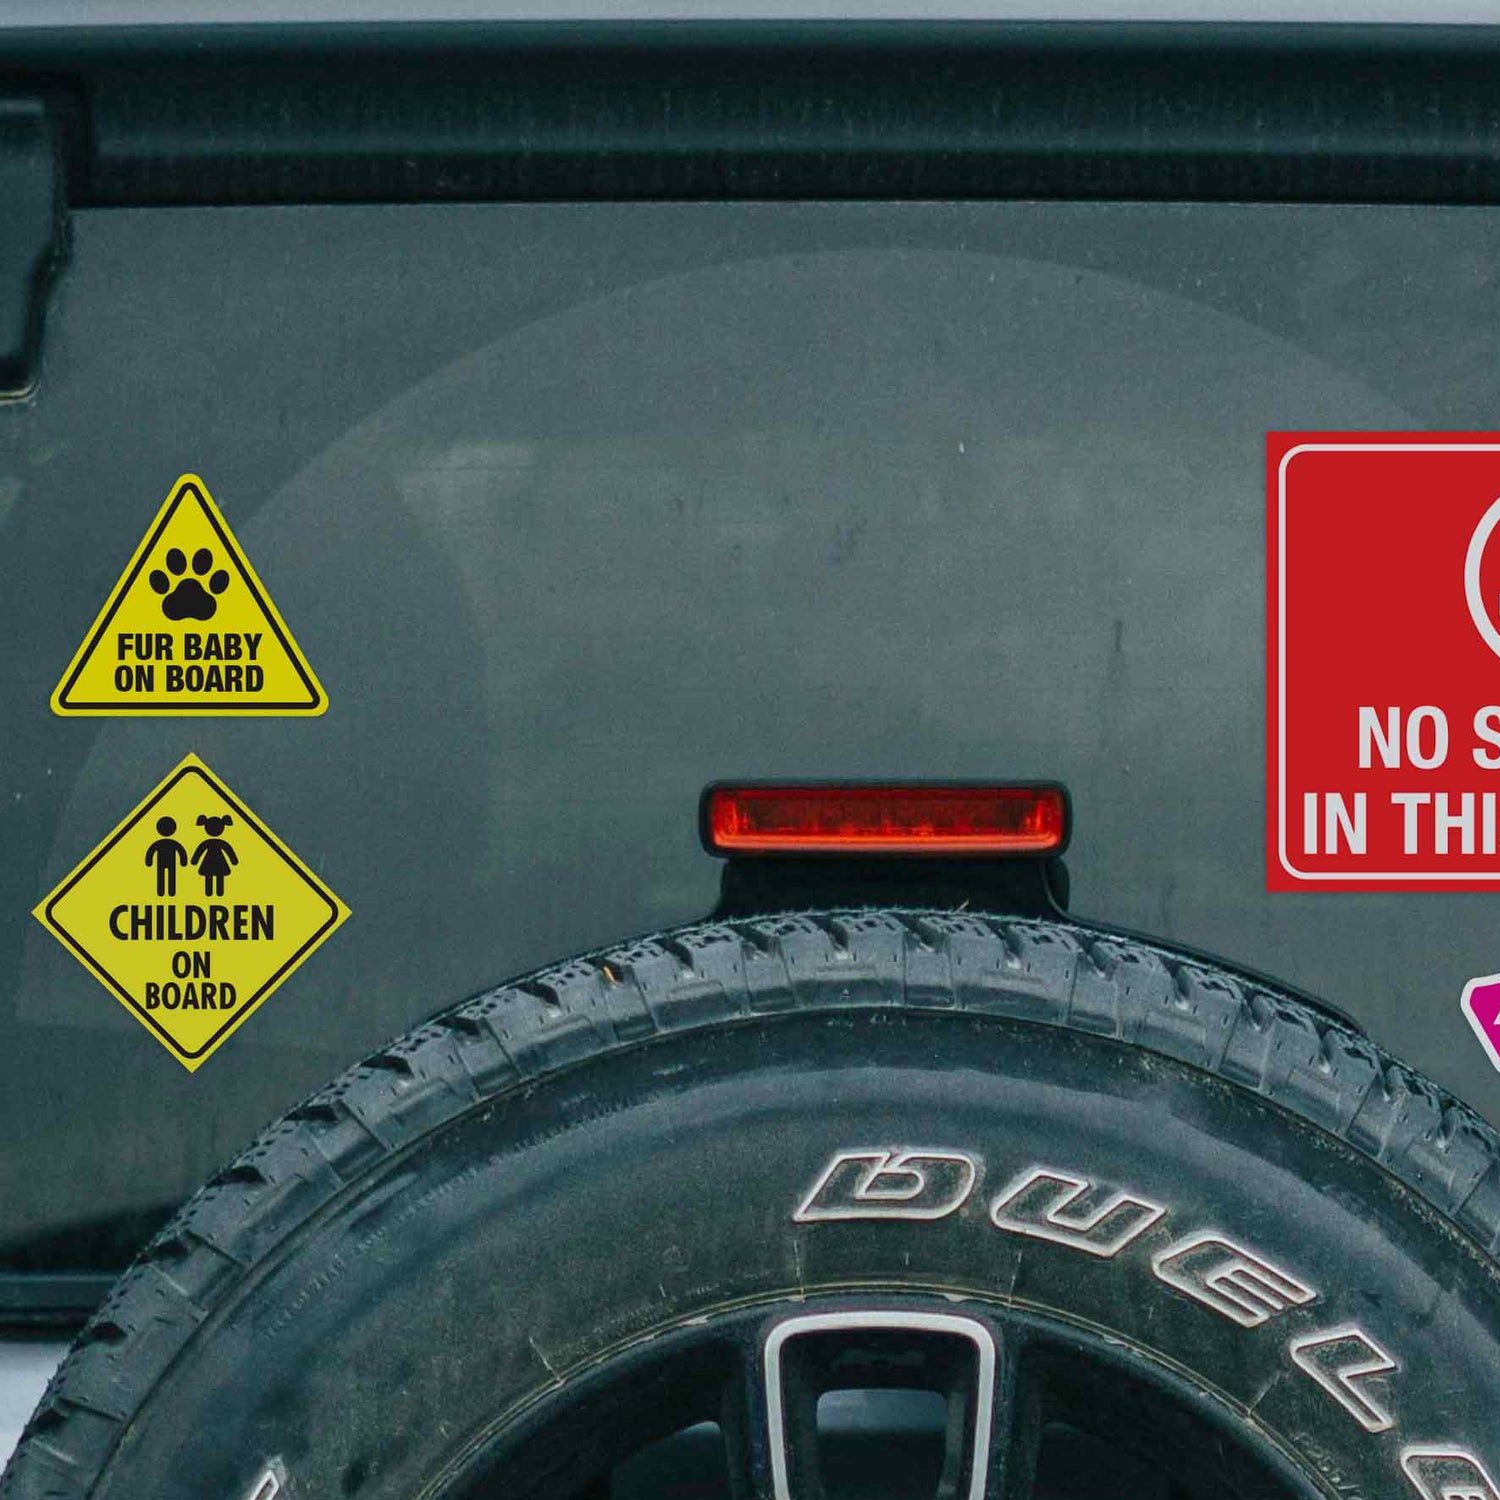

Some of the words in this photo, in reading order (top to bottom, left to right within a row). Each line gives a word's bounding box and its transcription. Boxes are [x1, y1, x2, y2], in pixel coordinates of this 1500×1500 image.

[118, 634, 173, 660] FUR
[185, 634, 262, 660] BABY
[115, 665, 154, 692] ON
[166, 665, 263, 692] BOARD
[1359, 706, 1448, 769] NO
[1305, 793, 1366, 854] IN
[109, 905, 273, 940] CHILDREN
[172, 951, 210, 978] ON
[145, 982, 236, 1010] BOARD
